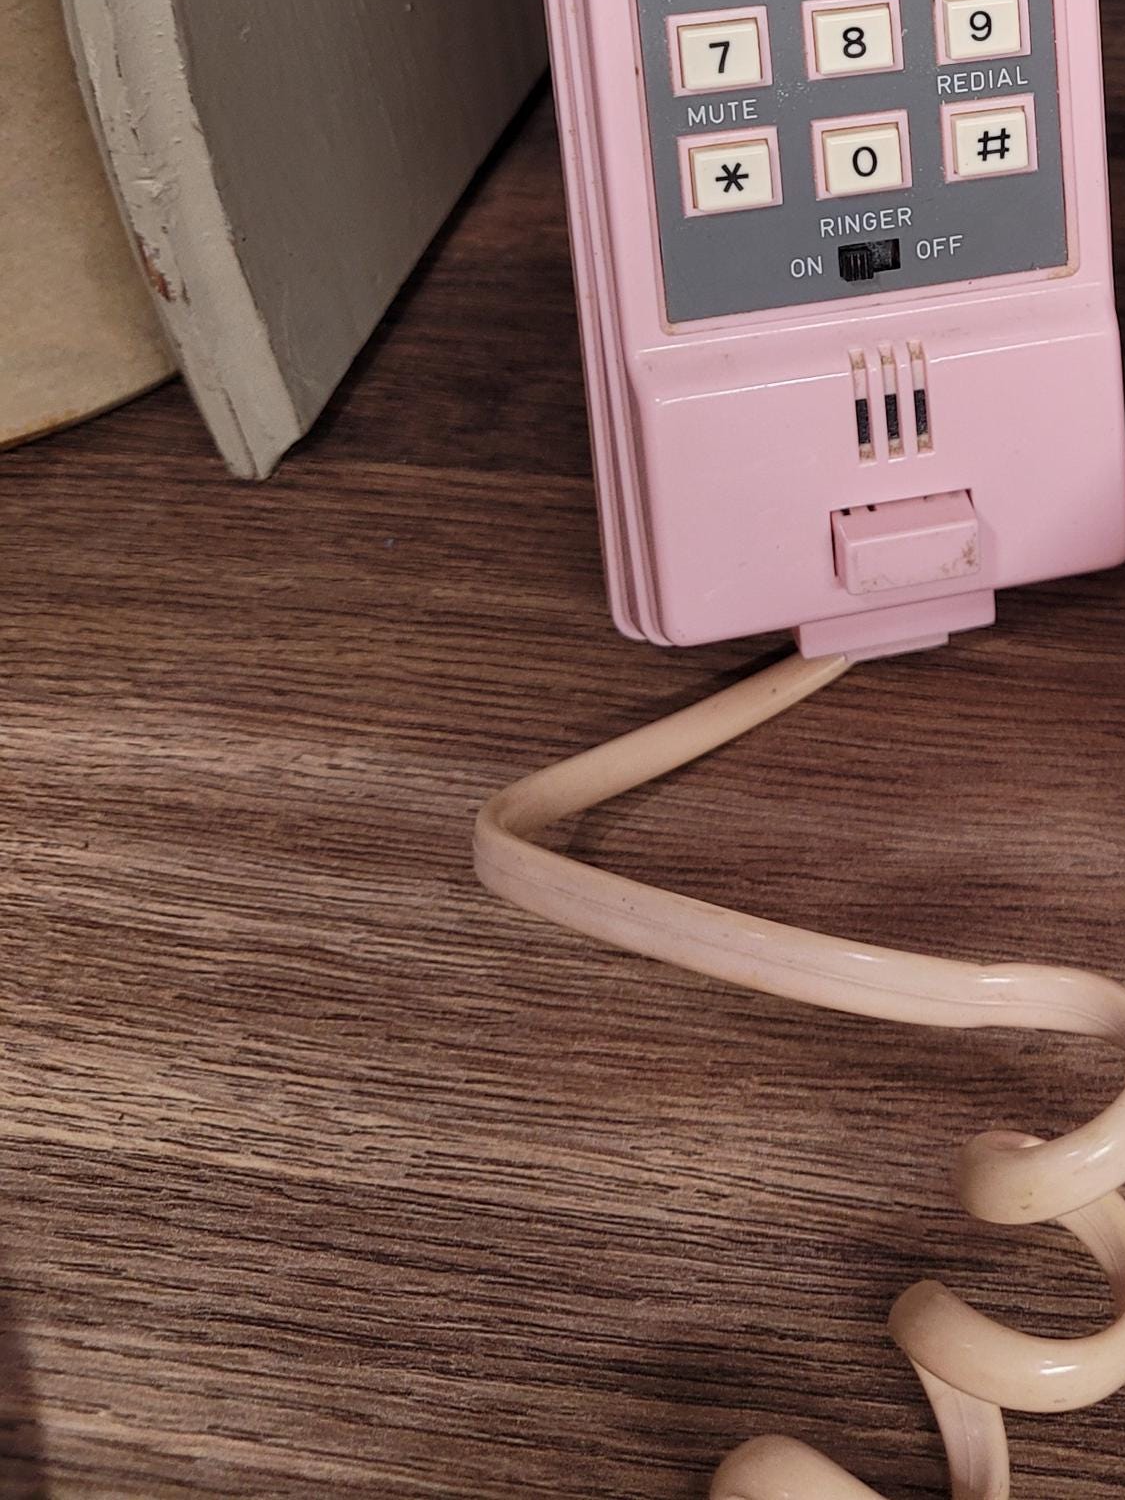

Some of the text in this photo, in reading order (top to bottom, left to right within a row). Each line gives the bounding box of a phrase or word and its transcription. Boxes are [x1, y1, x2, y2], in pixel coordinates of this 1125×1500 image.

[708, 10, 993, 74] 7 8 9
[937, 66, 1029, 95] REDIAL
[687, 99, 759, 127] MUTE
[852, 145, 878, 178] 0
[977, 127, 1011, 161] #
[819, 207, 913, 238] RINGER
[790, 235, 964, 280] ON OFF
